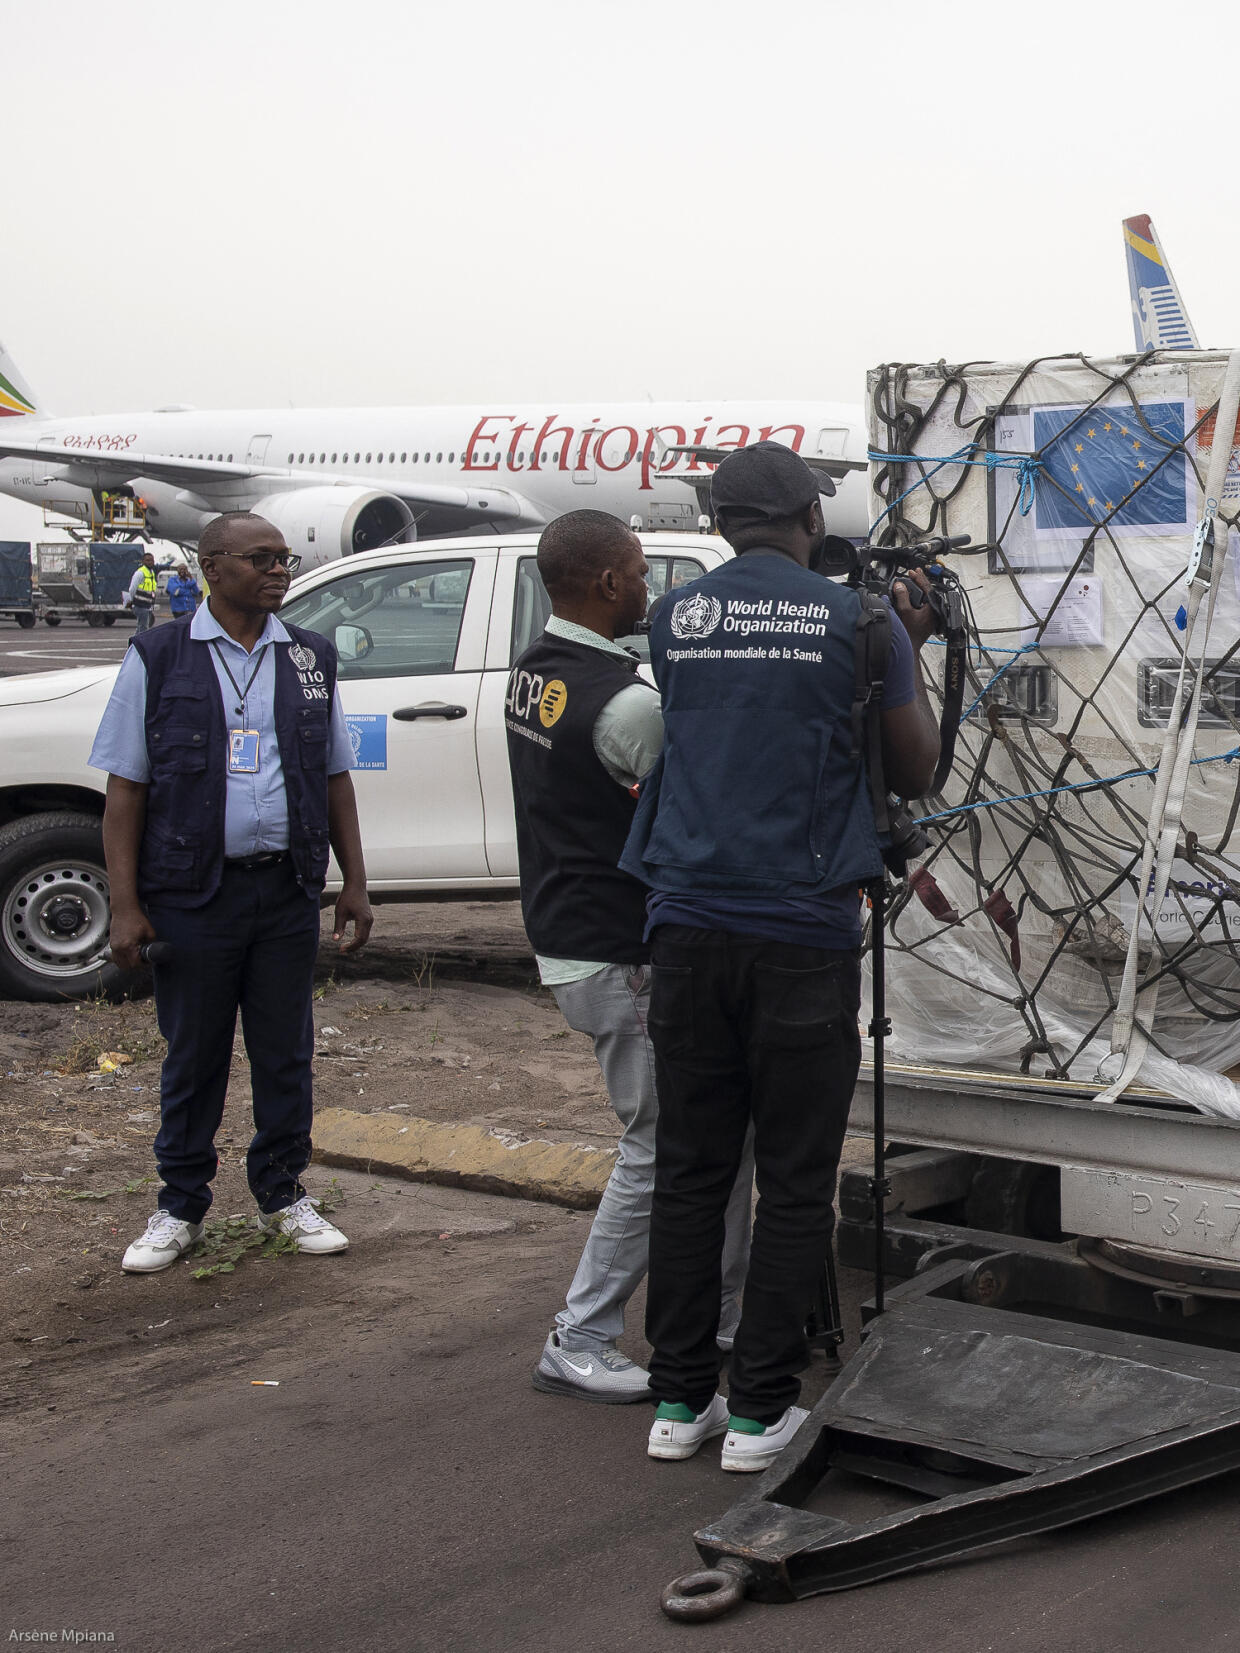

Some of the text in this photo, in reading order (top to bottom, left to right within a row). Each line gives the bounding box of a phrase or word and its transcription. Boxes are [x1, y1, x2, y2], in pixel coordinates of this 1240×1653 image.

[460, 414, 806, 490] Ethiopian
[726, 600, 830, 620] World Health
[723, 616, 827, 637] Organization
[666, 646, 823, 663] Organisation mondiale de la Santé
[303, 687, 329, 700] OMS
[505, 666, 544, 720] ACP
